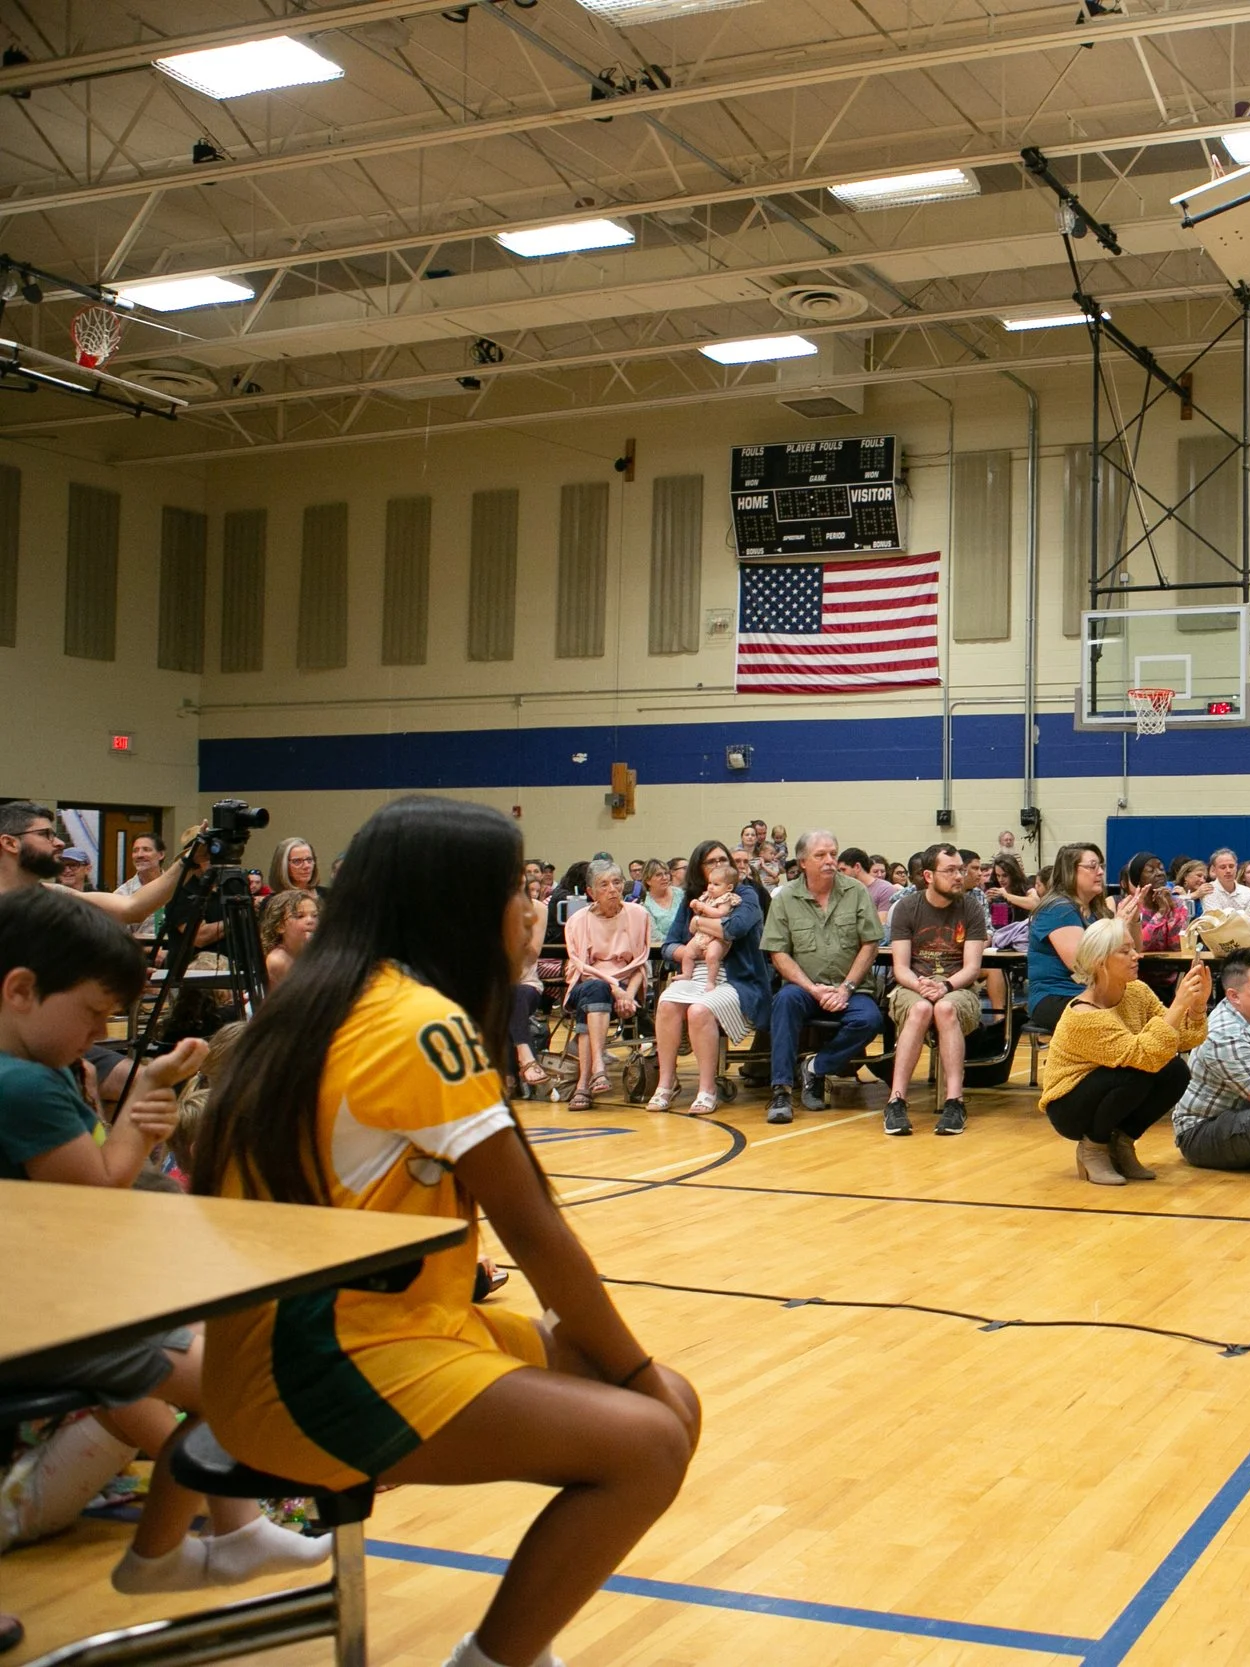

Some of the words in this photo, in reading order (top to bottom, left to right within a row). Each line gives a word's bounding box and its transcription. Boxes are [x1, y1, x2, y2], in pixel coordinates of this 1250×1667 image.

[786, 442, 816, 454] PLAYER
[819, 441, 843, 451] FOULS
[860, 438, 885, 448] FOULS
[741, 446, 764, 457] FOULS
[809, 474, 827, 482] GAME
[864, 471, 879, 479] WON
[745, 479, 759, 487] WON
[851, 487, 892, 503] VISITOR
[737, 495, 769, 510] HOME
[826, 531, 846, 540] PERIOD
[873, 540, 892, 548] BONUS
[746, 547, 764, 556] BONUS
